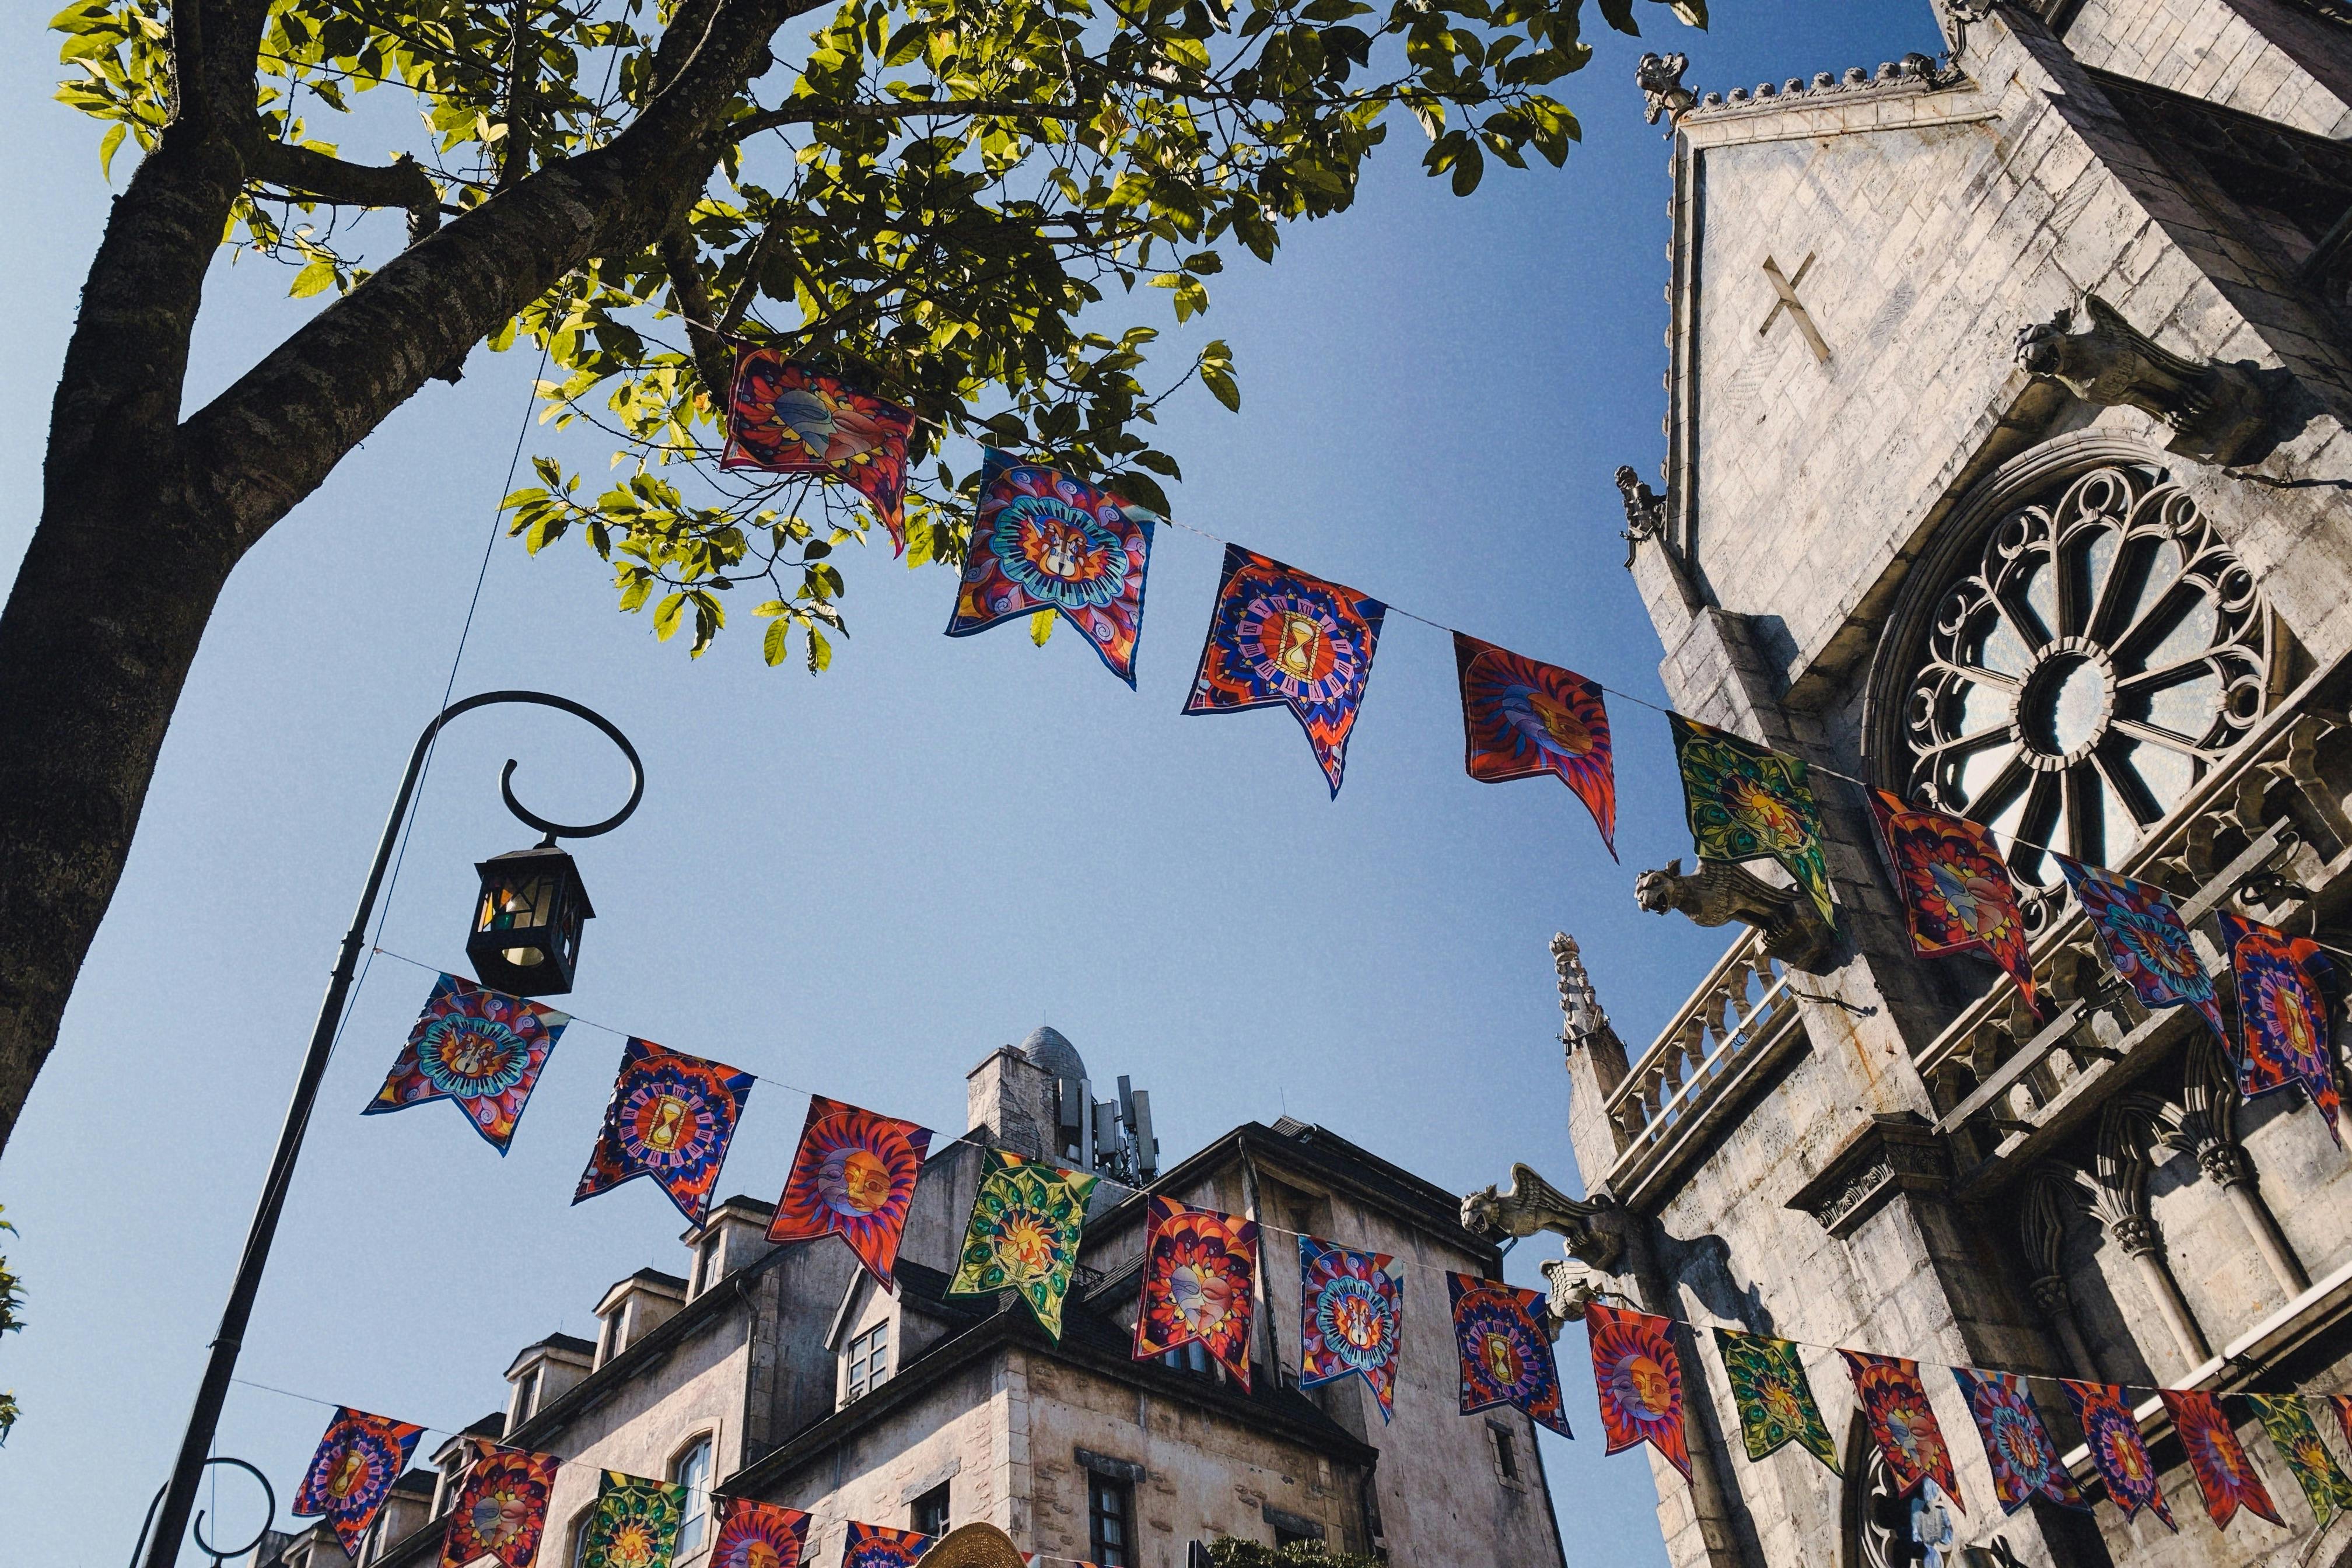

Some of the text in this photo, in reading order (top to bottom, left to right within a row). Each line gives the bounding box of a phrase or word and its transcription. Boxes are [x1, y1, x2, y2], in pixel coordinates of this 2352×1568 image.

[1254, 604, 1269, 615] X
[1297, 602, 1312, 617] XII
[1242, 624, 1258, 634] IX
[1258, 662, 1275, 678] VII
[1338, 661, 1350, 676] III
[673, 1087, 685, 1098] XII
[698, 1130, 710, 1140] III
